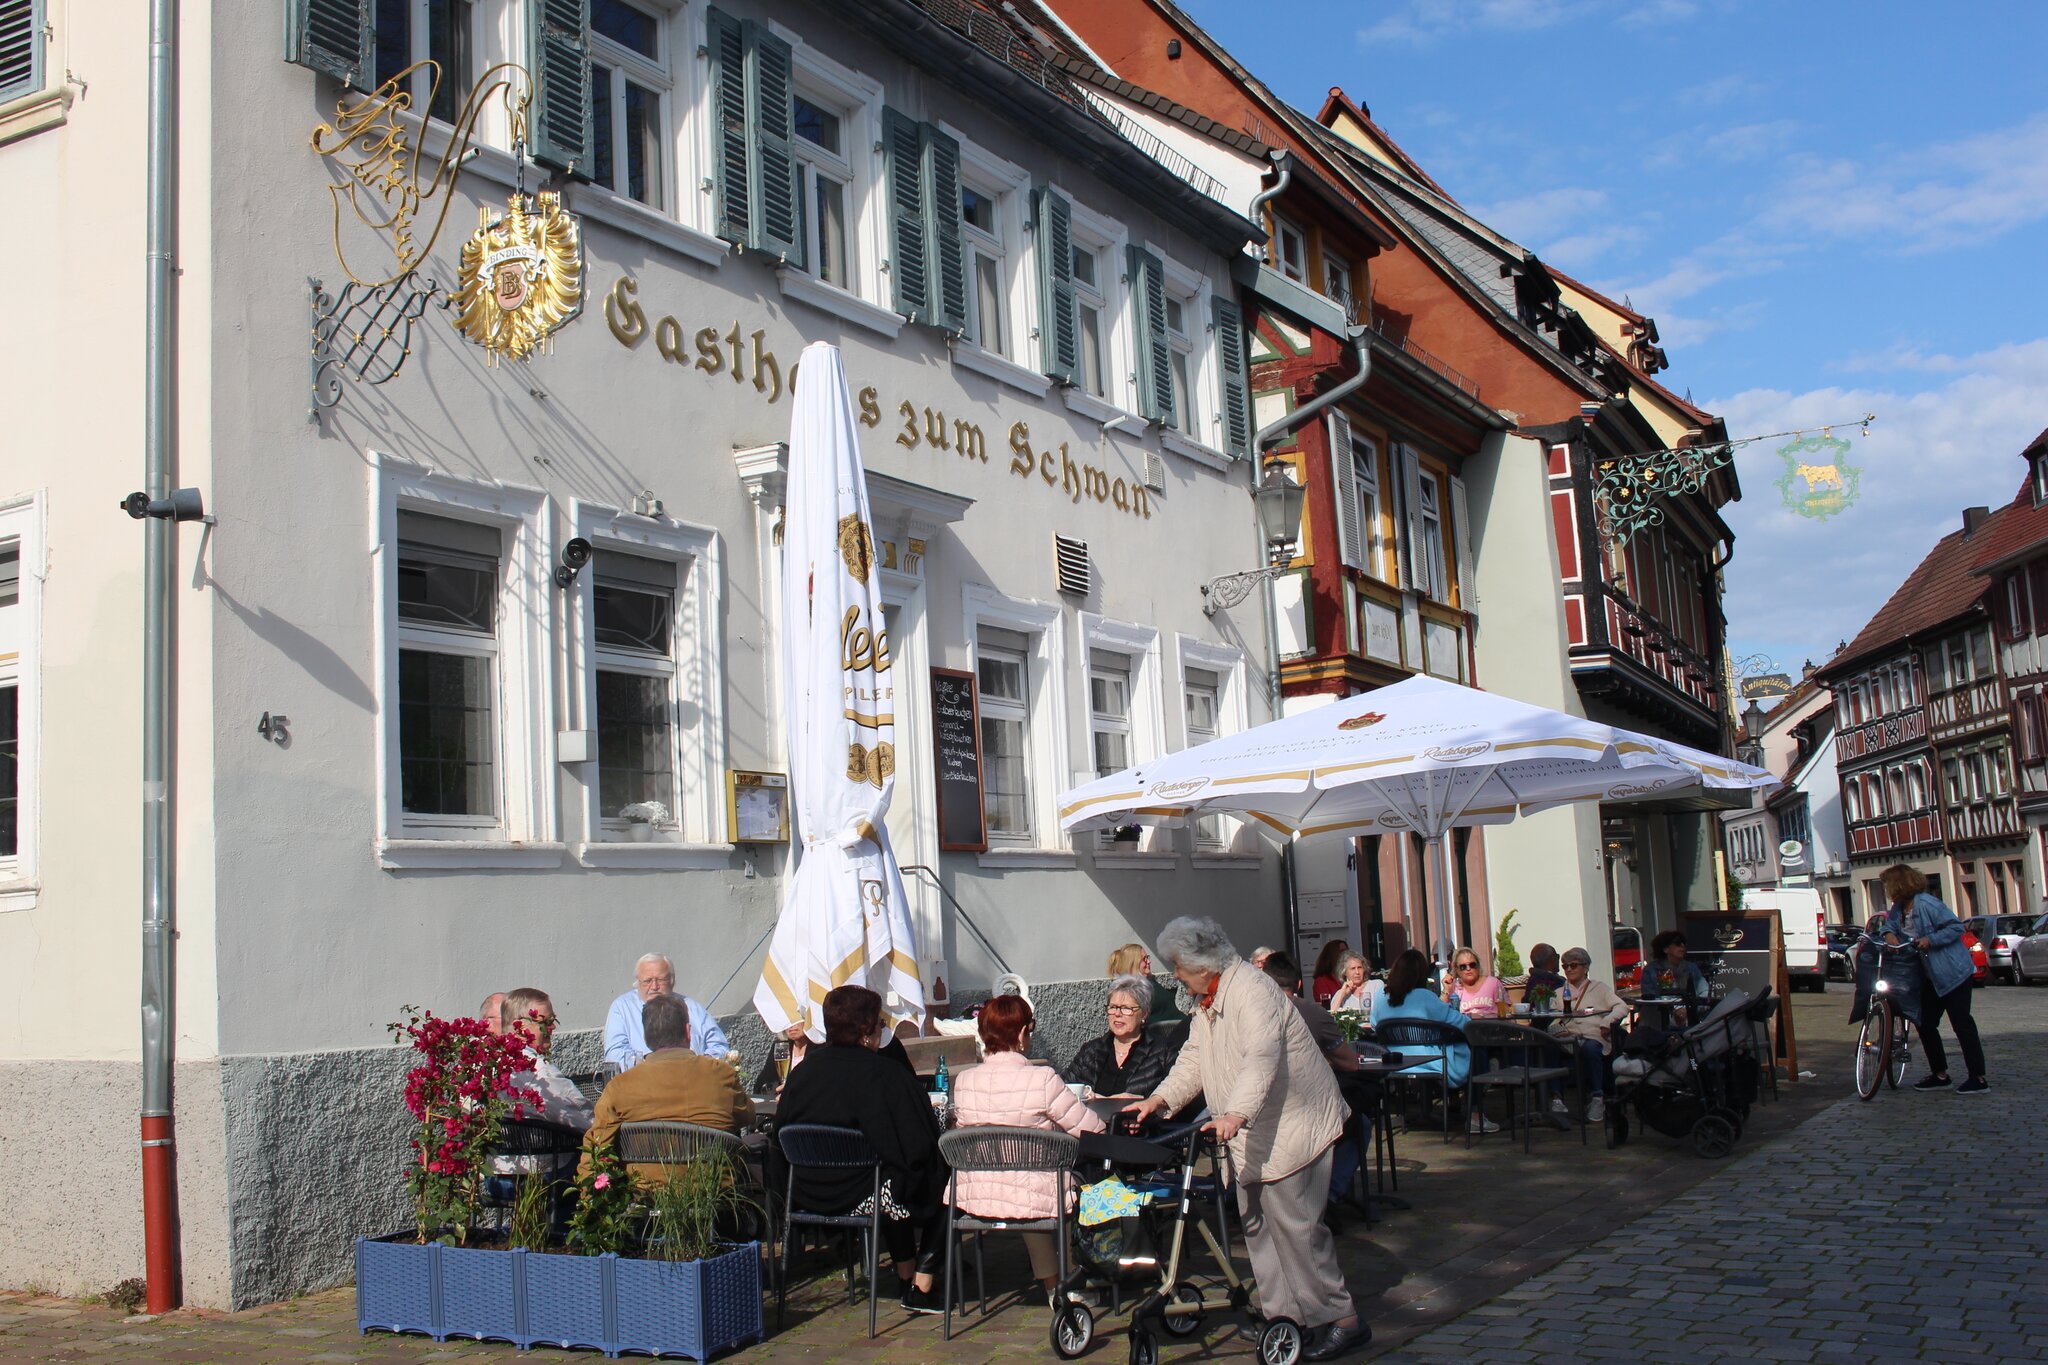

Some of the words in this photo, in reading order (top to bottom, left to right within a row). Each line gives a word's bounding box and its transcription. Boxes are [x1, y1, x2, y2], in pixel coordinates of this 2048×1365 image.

[490, 247, 528, 264] BINDING
[603, 276, 881, 428] Gasths
[896, 400, 988, 464] zum
[1008, 421, 1152, 519] Schwan
[1742, 677, 1791, 697] Antiquitäten
[258, 711, 288, 745] 45
[1419, 742, 1490, 761] Radeberger
[1147, 778, 1209, 797] Radeberger
[1461, 997, 1493, 1009] OHEME
